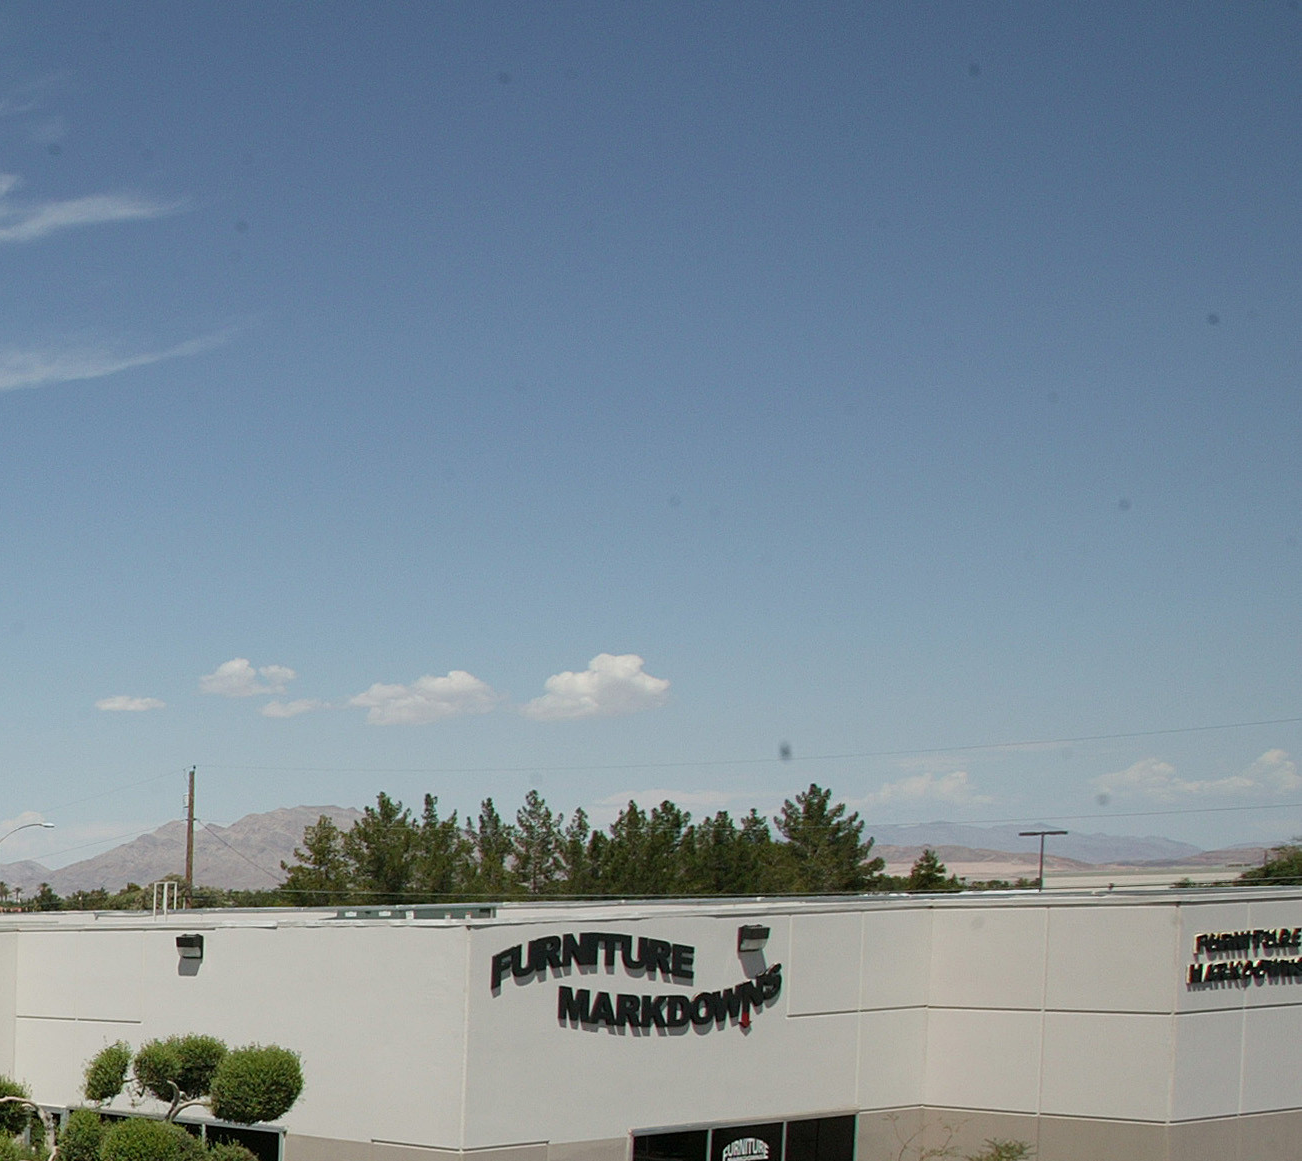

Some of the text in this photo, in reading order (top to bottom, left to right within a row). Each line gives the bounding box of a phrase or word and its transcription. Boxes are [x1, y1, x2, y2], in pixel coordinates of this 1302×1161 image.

[491, 932, 695, 990] FURNITURE
[1194, 928, 1302, 954] FURNITURE
[558, 963, 783, 1028] MARKDOWNS
